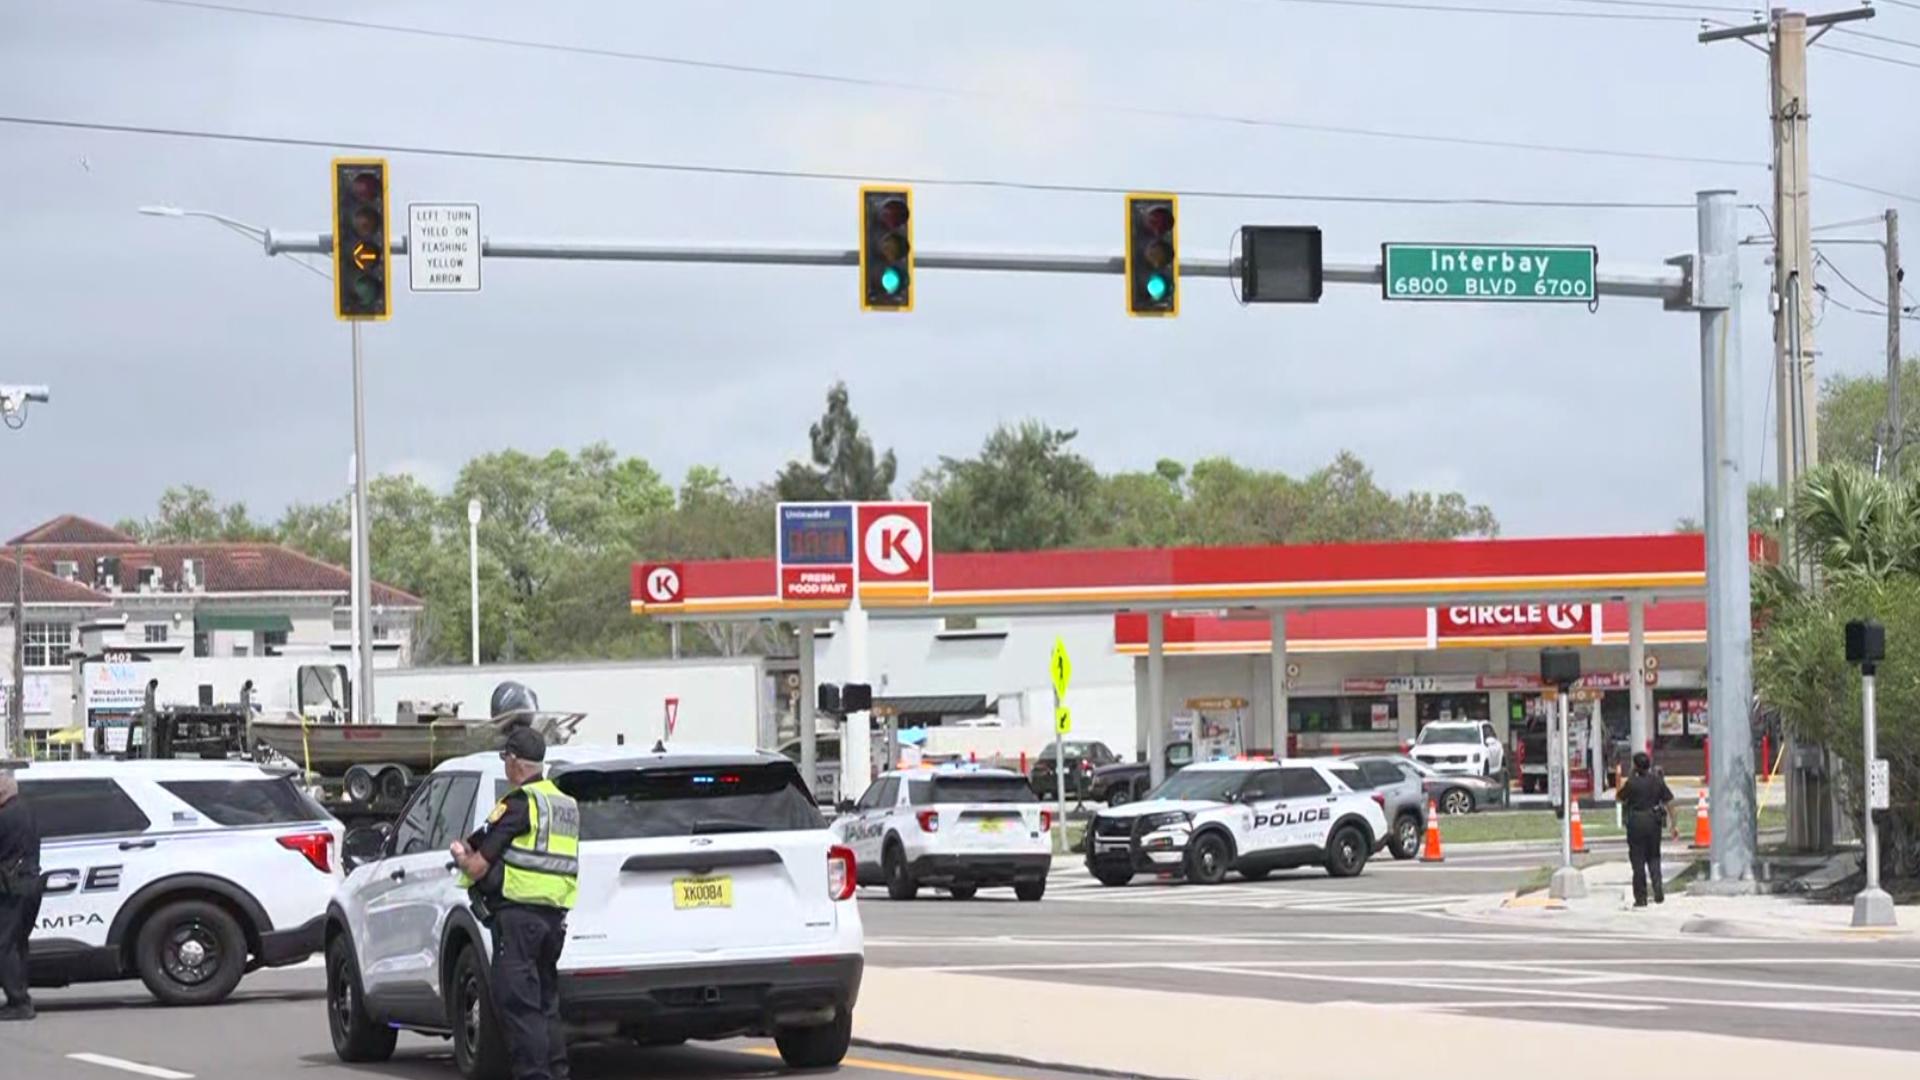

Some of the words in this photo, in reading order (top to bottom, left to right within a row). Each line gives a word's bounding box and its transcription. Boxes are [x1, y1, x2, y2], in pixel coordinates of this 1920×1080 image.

[417, 211, 438, 221] LEFT
[447, 211, 471, 221] TURN
[422, 226, 448, 236] YIELD
[455, 226, 468, 236] ON
[422, 242, 467, 252] FLASHING
[428, 258, 463, 268] YELLOW
[1431, 250, 1549, 277] Interbay
[429, 274, 462, 283] ARROW
[1394, 277, 1448, 294] 6800
[1465, 278, 1517, 295] BLVD
[1534, 279, 1587, 296] 6700
[785, 510, 831, 520] Unleaded
[800, 573, 836, 583] FRESH
[788, 583, 819, 594] FOOD
[820, 583, 848, 594] FAST
[1449, 604, 1542, 625] CIRCLE
[104, 652, 132, 663] 6402
[1253, 808, 1331, 829] POLICE
[35, 913, 104, 929] MPA
